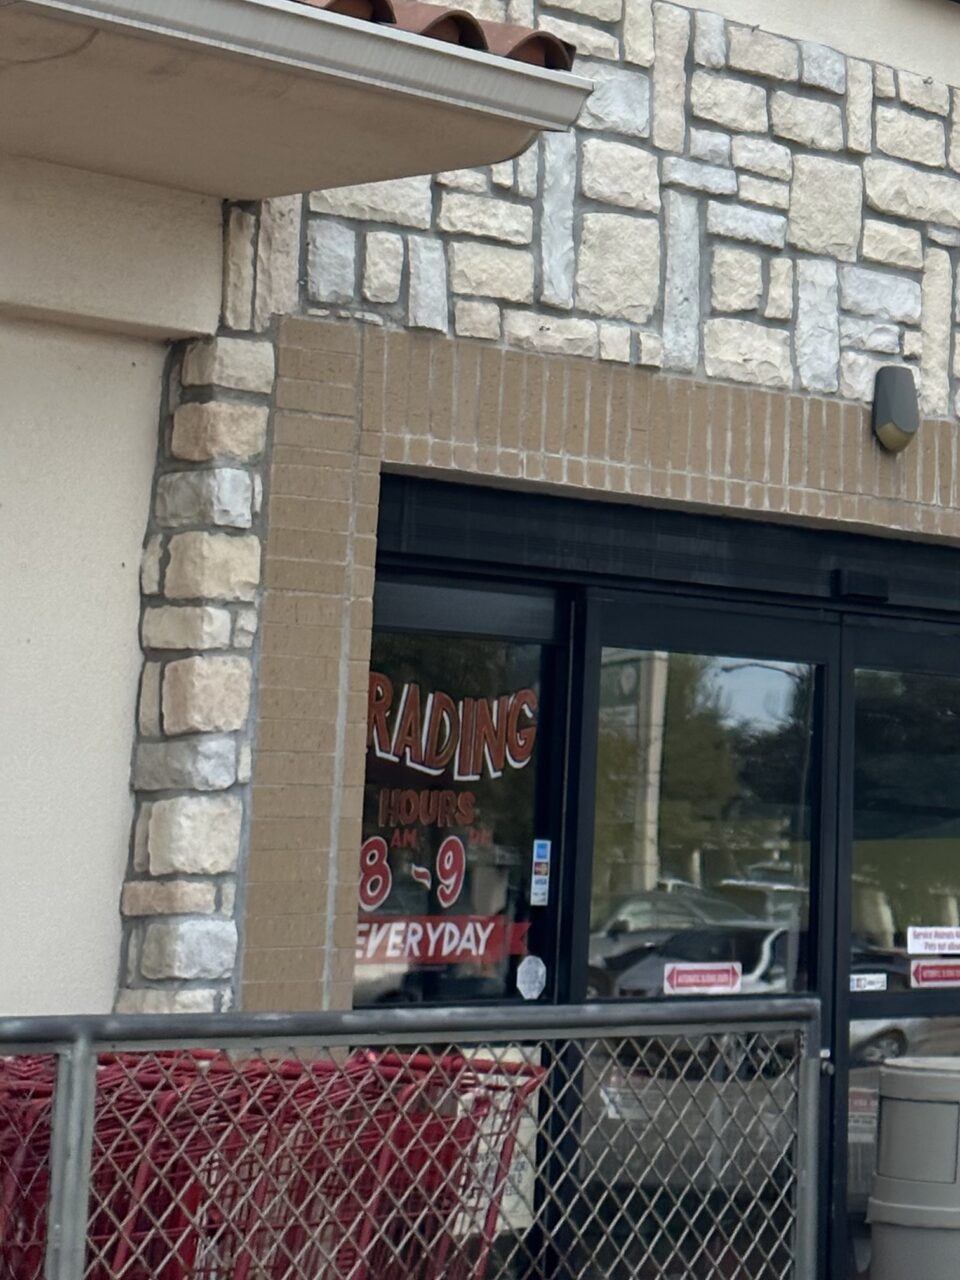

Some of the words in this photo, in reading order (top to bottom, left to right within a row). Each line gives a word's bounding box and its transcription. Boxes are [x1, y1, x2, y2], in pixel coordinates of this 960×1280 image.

[365, 671, 538, 781] RADING
[379, 788, 477, 828] HOURS
[391, 827, 418, 849] AM
[355, 921, 495, 960] EVERYDAY
